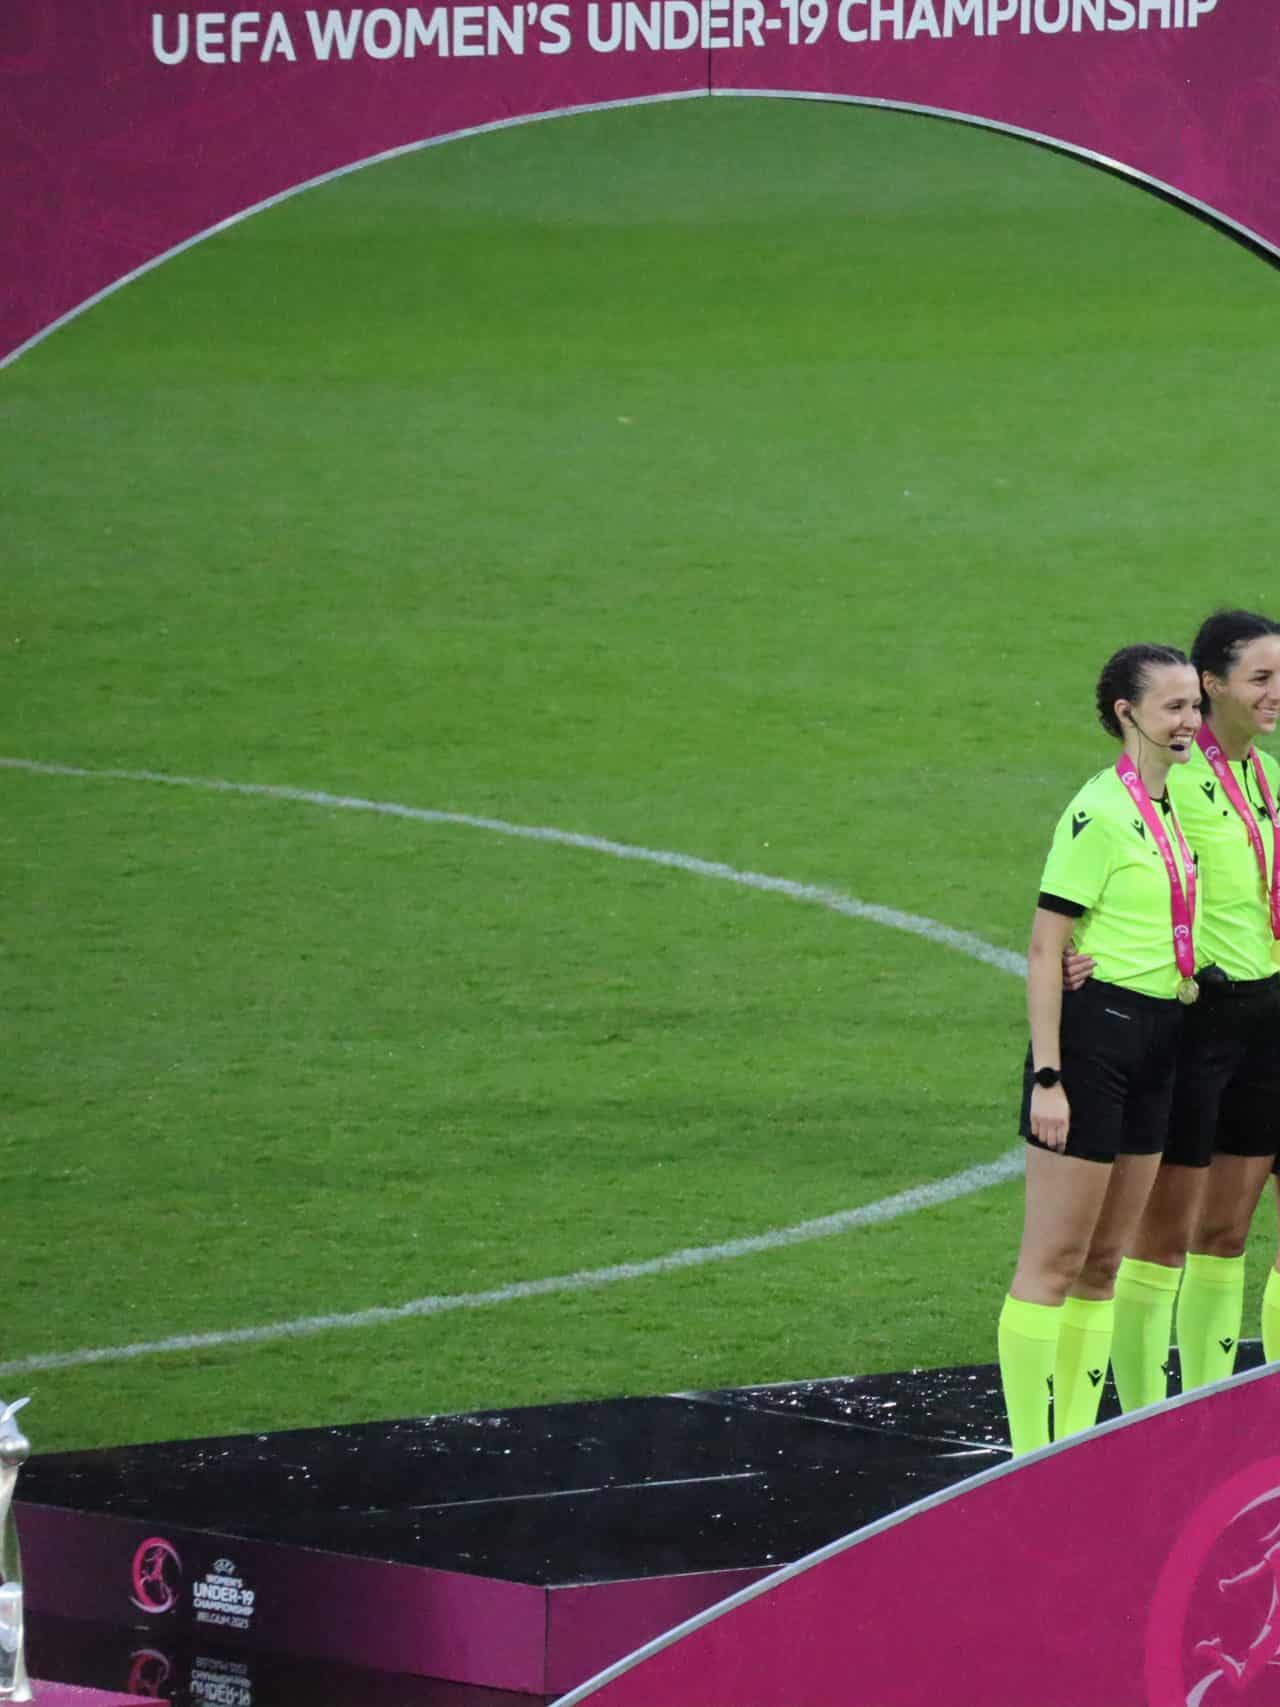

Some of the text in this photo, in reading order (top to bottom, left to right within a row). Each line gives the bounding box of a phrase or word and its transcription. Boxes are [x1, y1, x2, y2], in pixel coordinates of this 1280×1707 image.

[151, 0, 1219, 65] UEFA WOMEN'S UNDER-19 CHAMPIONSHIP
[193, 1582, 255, 1606] UNDER-19
